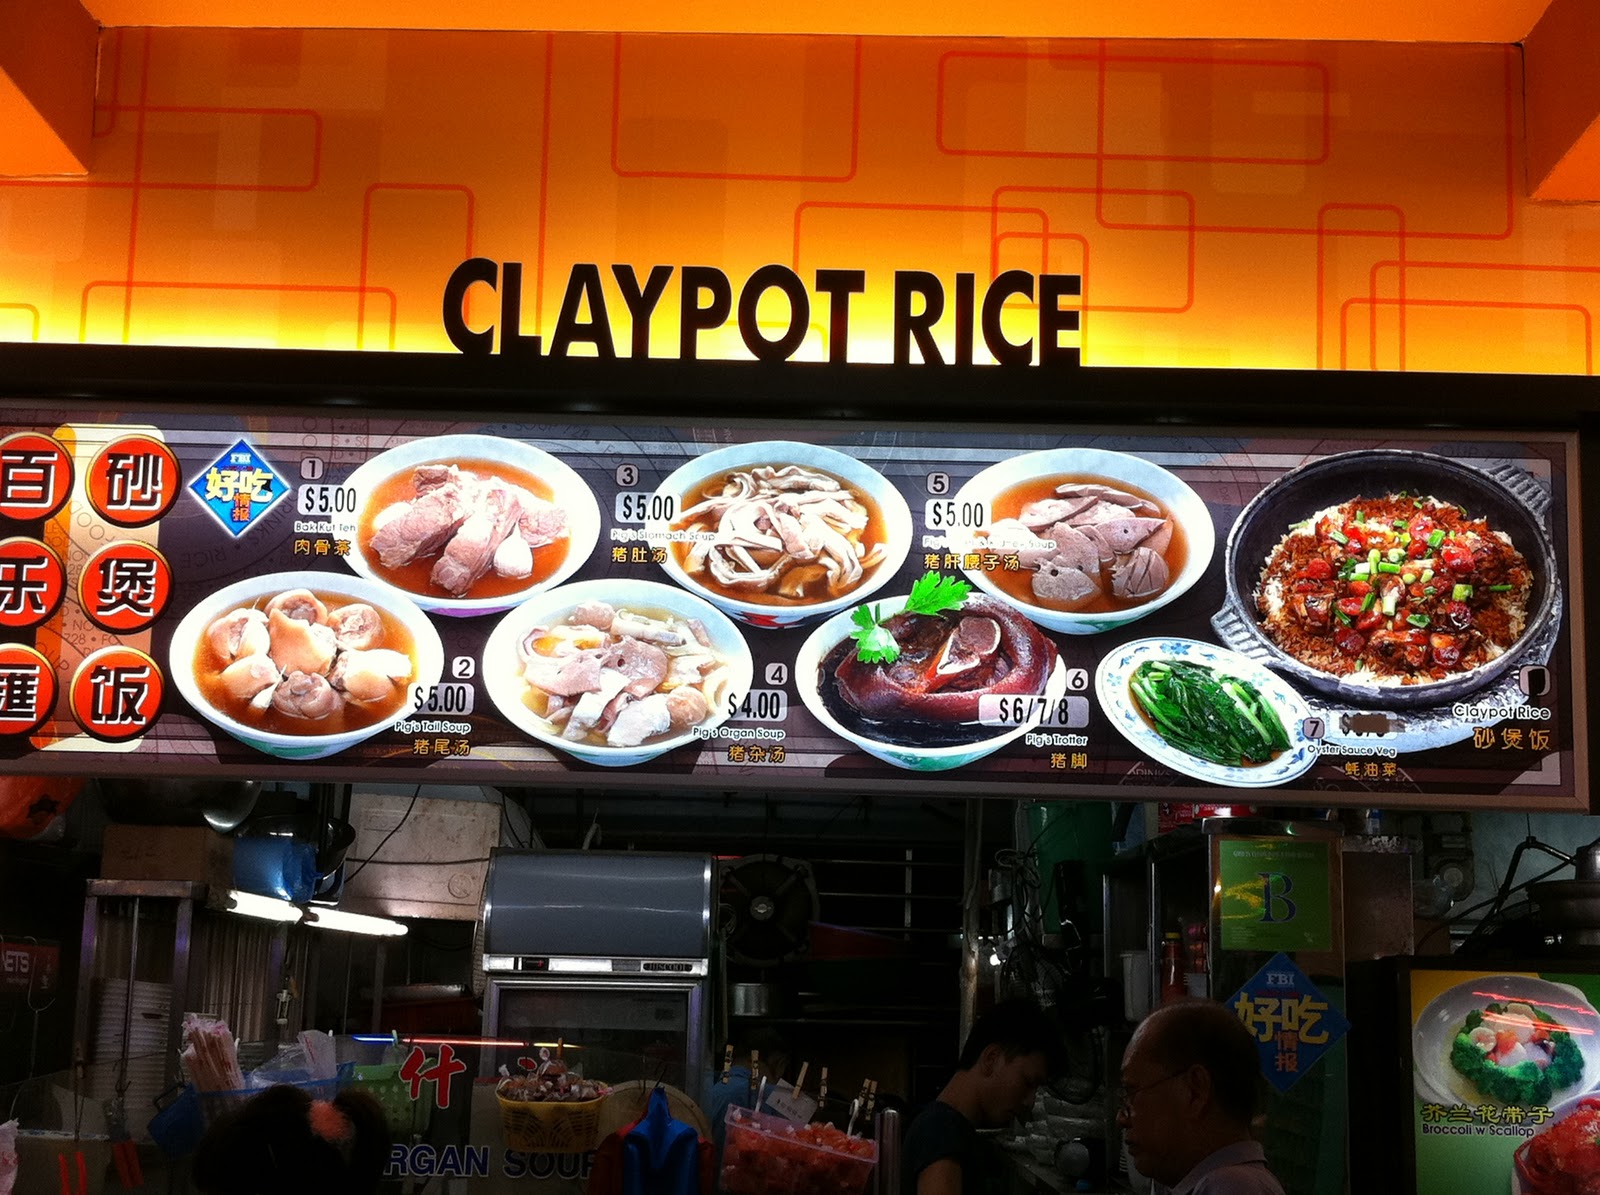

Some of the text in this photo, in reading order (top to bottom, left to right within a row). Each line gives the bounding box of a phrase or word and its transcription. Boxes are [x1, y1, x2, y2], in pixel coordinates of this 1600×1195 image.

[443, 257, 1081, 367] CLAYPOT RICE
[308, 459, 317, 478] 1
[621, 466, 635, 485] 3
[204, 466, 275, 503] 好吃
[932, 474, 946, 493] 5
[304, 486, 357, 513] $5.00
[622, 494, 675, 521] $5.00
[932, 501, 984, 528] $5.00
[295, 521, 316, 532] Bak
[293, 538, 352, 556] 肉骨茶
[611, 546, 668, 563] 猪肚汤
[90, 451, 164, 726] 砂煲饭
[457, 658, 471, 677] 2
[770, 665, 784, 684] 4
[1071, 670, 1085, 689] 6
[414, 685, 467, 713] $5.00
[728, 691, 781, 719] $4.00
[999, 697, 1070, 725] $6/7/8
[1453, 704, 1550, 721] Claypot Rice
[395, 721, 471, 734] Pig's Tail Soup
[693, 727, 786, 740] Pig's Organ Soup
[1309, 720, 1320, 737] 7
[413, 738, 471, 757] 猪尾汤
[1026, 733, 1088, 747] Pig's Trotter
[1472, 726, 1551, 751] 砂煲饭
[728, 745, 786, 763] 猪杂汤
[1050, 752, 1088, 770] 猪脚
[1307, 744, 1397, 759] Oyster Sauce Veg
[1344, 761, 1398, 778] 蚝油菜
[1257, 872, 1297, 923] B
[1266, 973, 1295, 986] FBI
[1234, 991, 1330, 1045] 好吃
[400, 1044, 467, 1110] 什
[1420, 1103, 1556, 1125] 芥兰花带子
[1422, 1123, 1535, 1138] Broccoli w Scallop
[384, 1144, 490, 1178] RGAN
